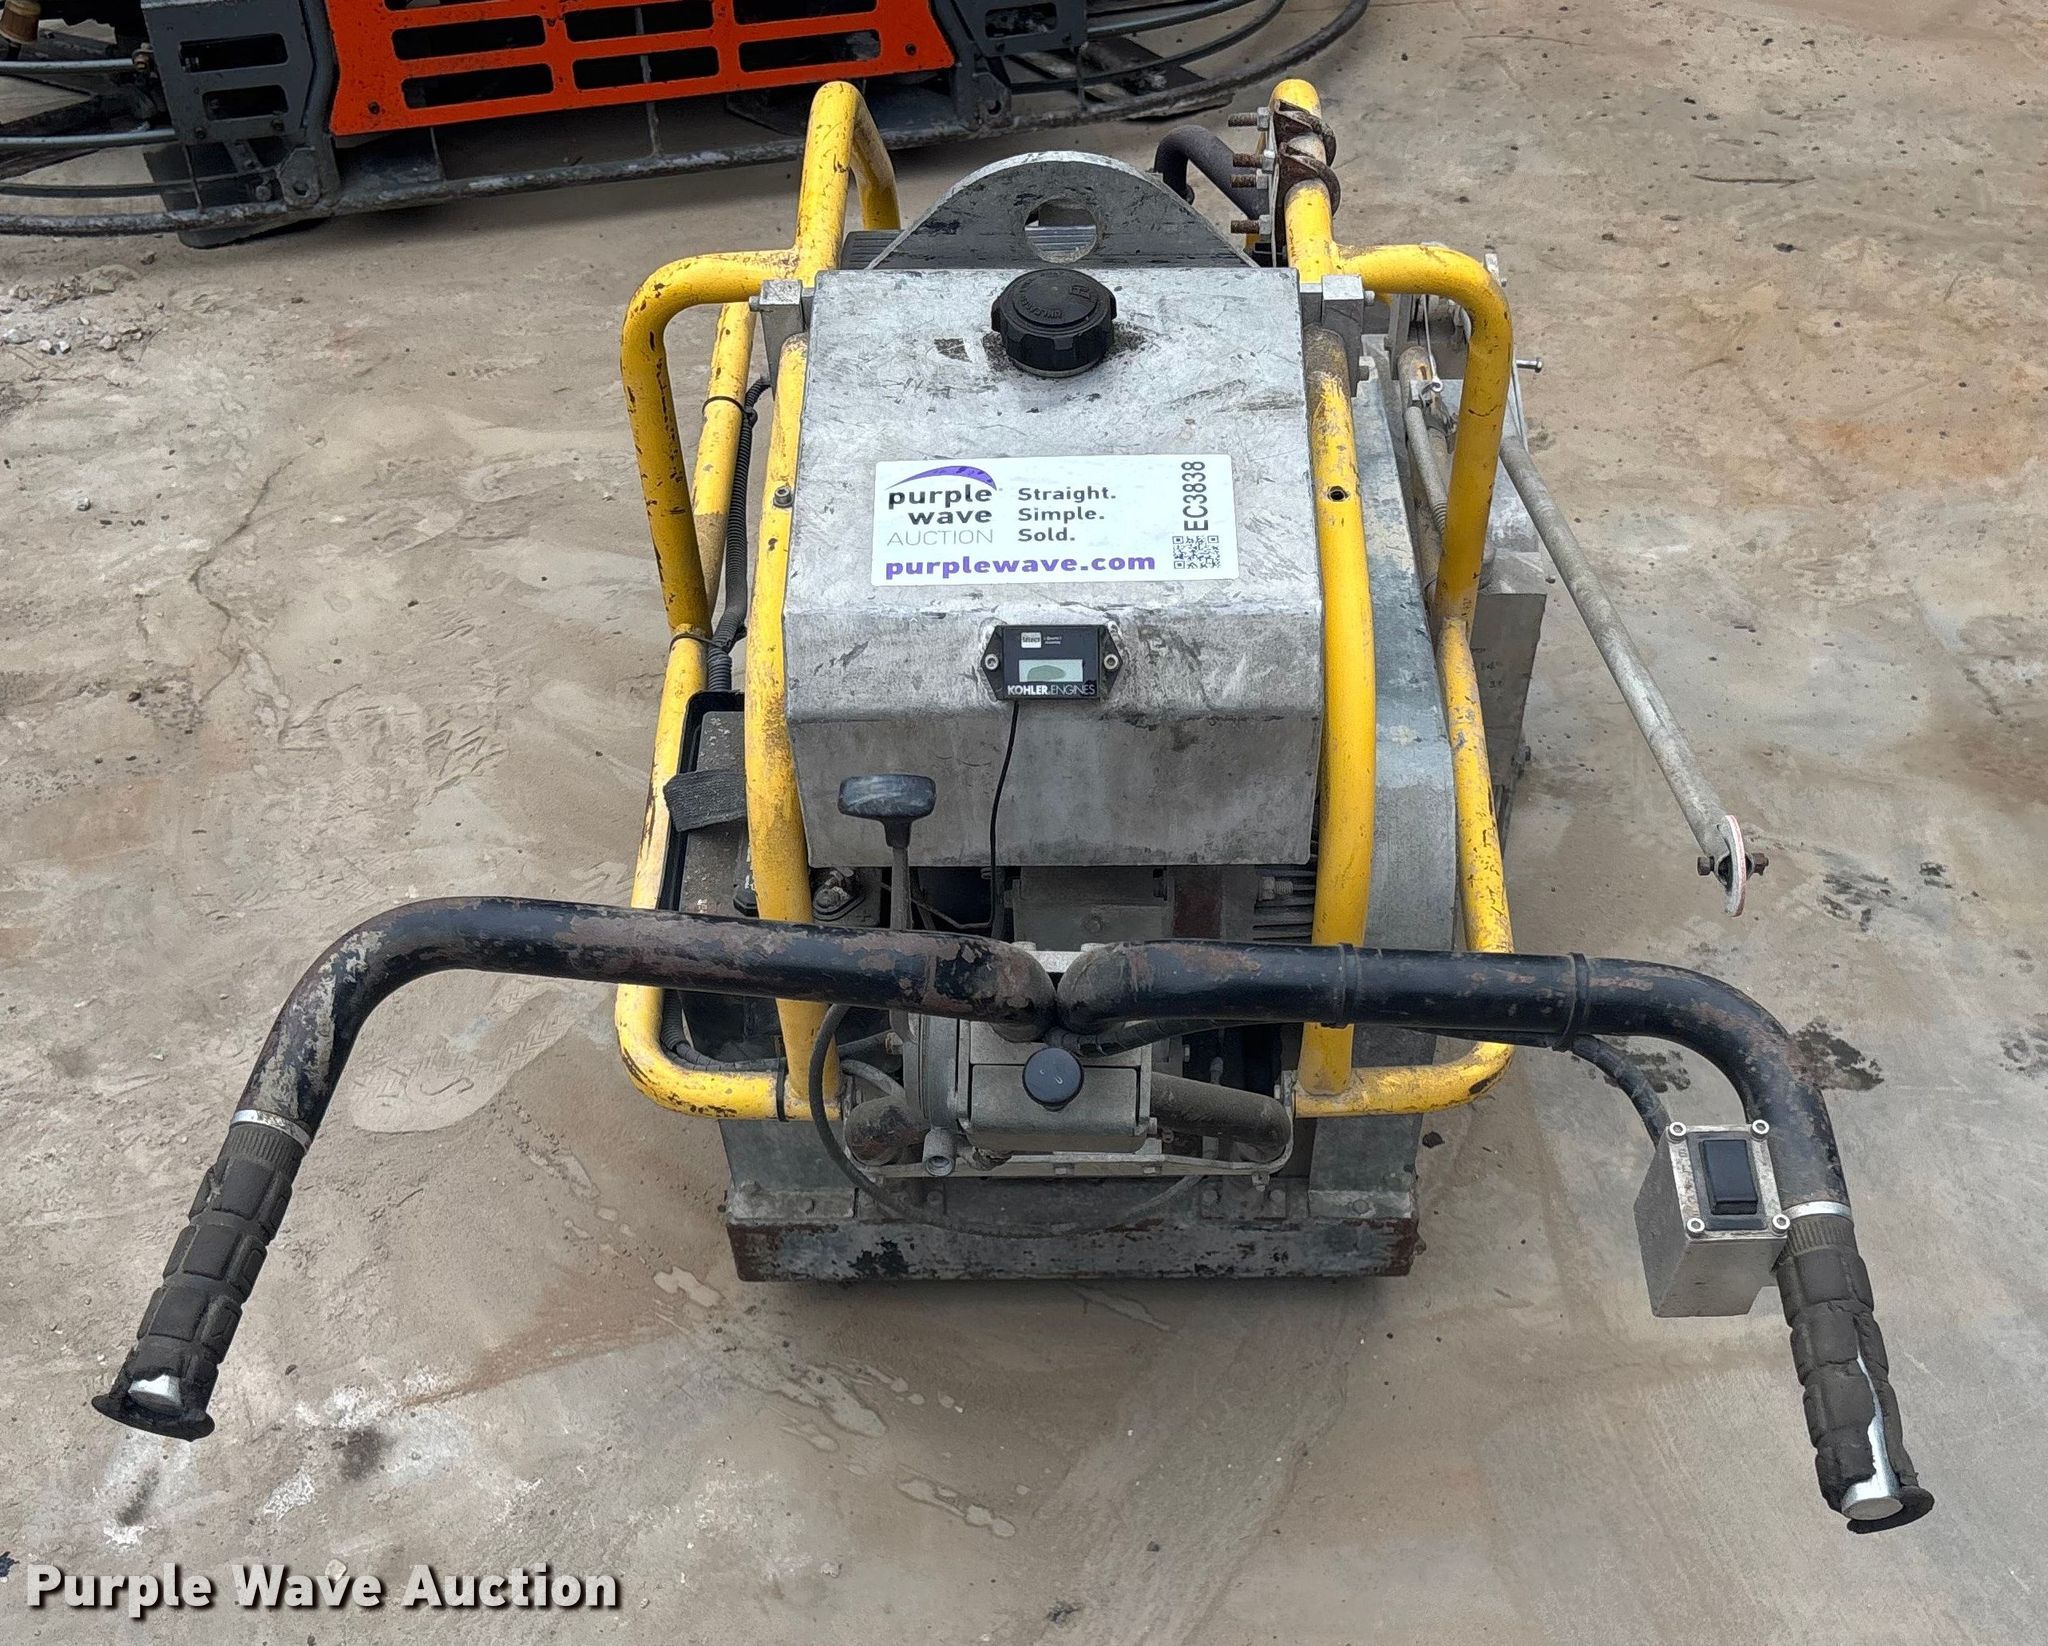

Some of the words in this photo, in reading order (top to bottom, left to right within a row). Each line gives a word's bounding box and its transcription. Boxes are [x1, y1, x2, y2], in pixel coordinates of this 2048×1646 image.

[888, 484, 992, 509] purple
[1018, 486, 1117, 504] Straight.
[1181, 461, 1209, 532] EC3838
[908, 510, 993, 526] wave
[1018, 506, 1105, 523] Simple.
[886, 529, 993, 547] AUCTION
[1018, 527, 1076, 543] Sold.
[885, 554, 1156, 580] purplewave.com
[1007, 685, 1048, 696] KOHLER
[1050, 685, 1096, 696] ENGINES
